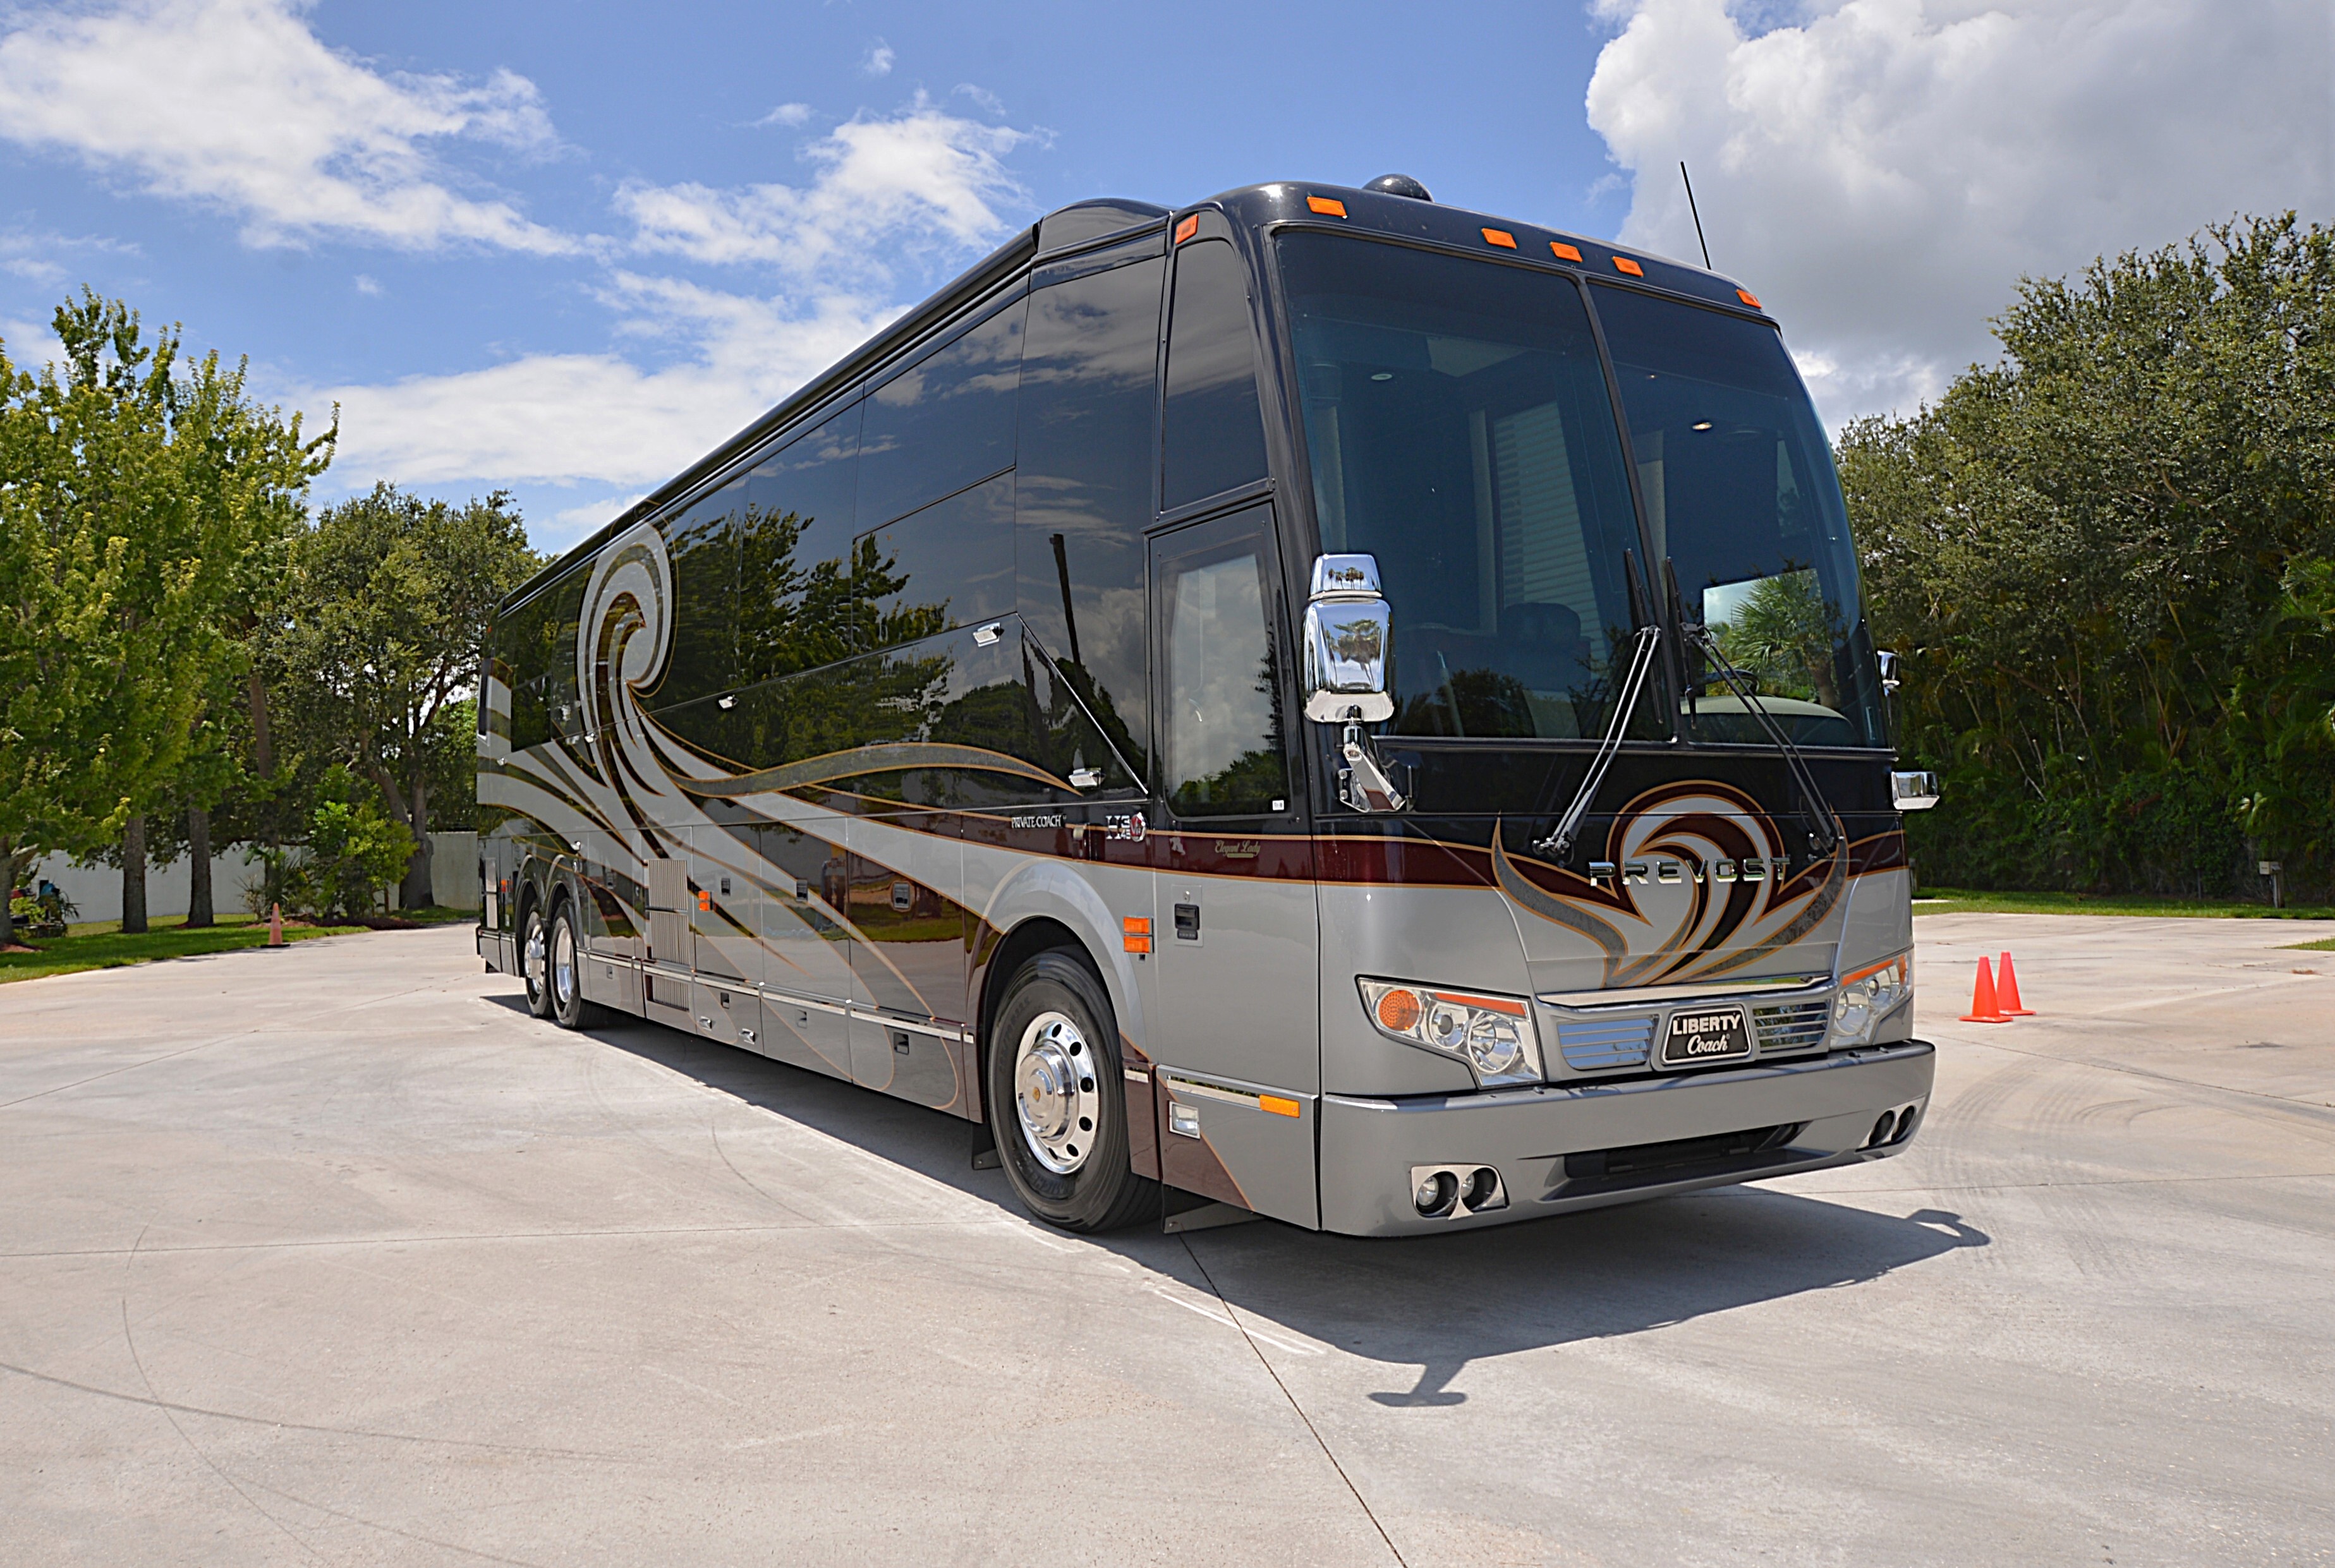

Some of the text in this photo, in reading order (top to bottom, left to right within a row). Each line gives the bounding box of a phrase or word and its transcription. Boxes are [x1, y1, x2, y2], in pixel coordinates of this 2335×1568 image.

[1036, 814, 1062, 828] COACH
[1105, 815, 1130, 840] H3
[1215, 840, 1261, 857] Elegant Lady
[1588, 857, 1791, 886] PREVOST
[1673, 1014, 1741, 1035] LIBERTY
[1687, 1034, 1728, 1055] Coach
